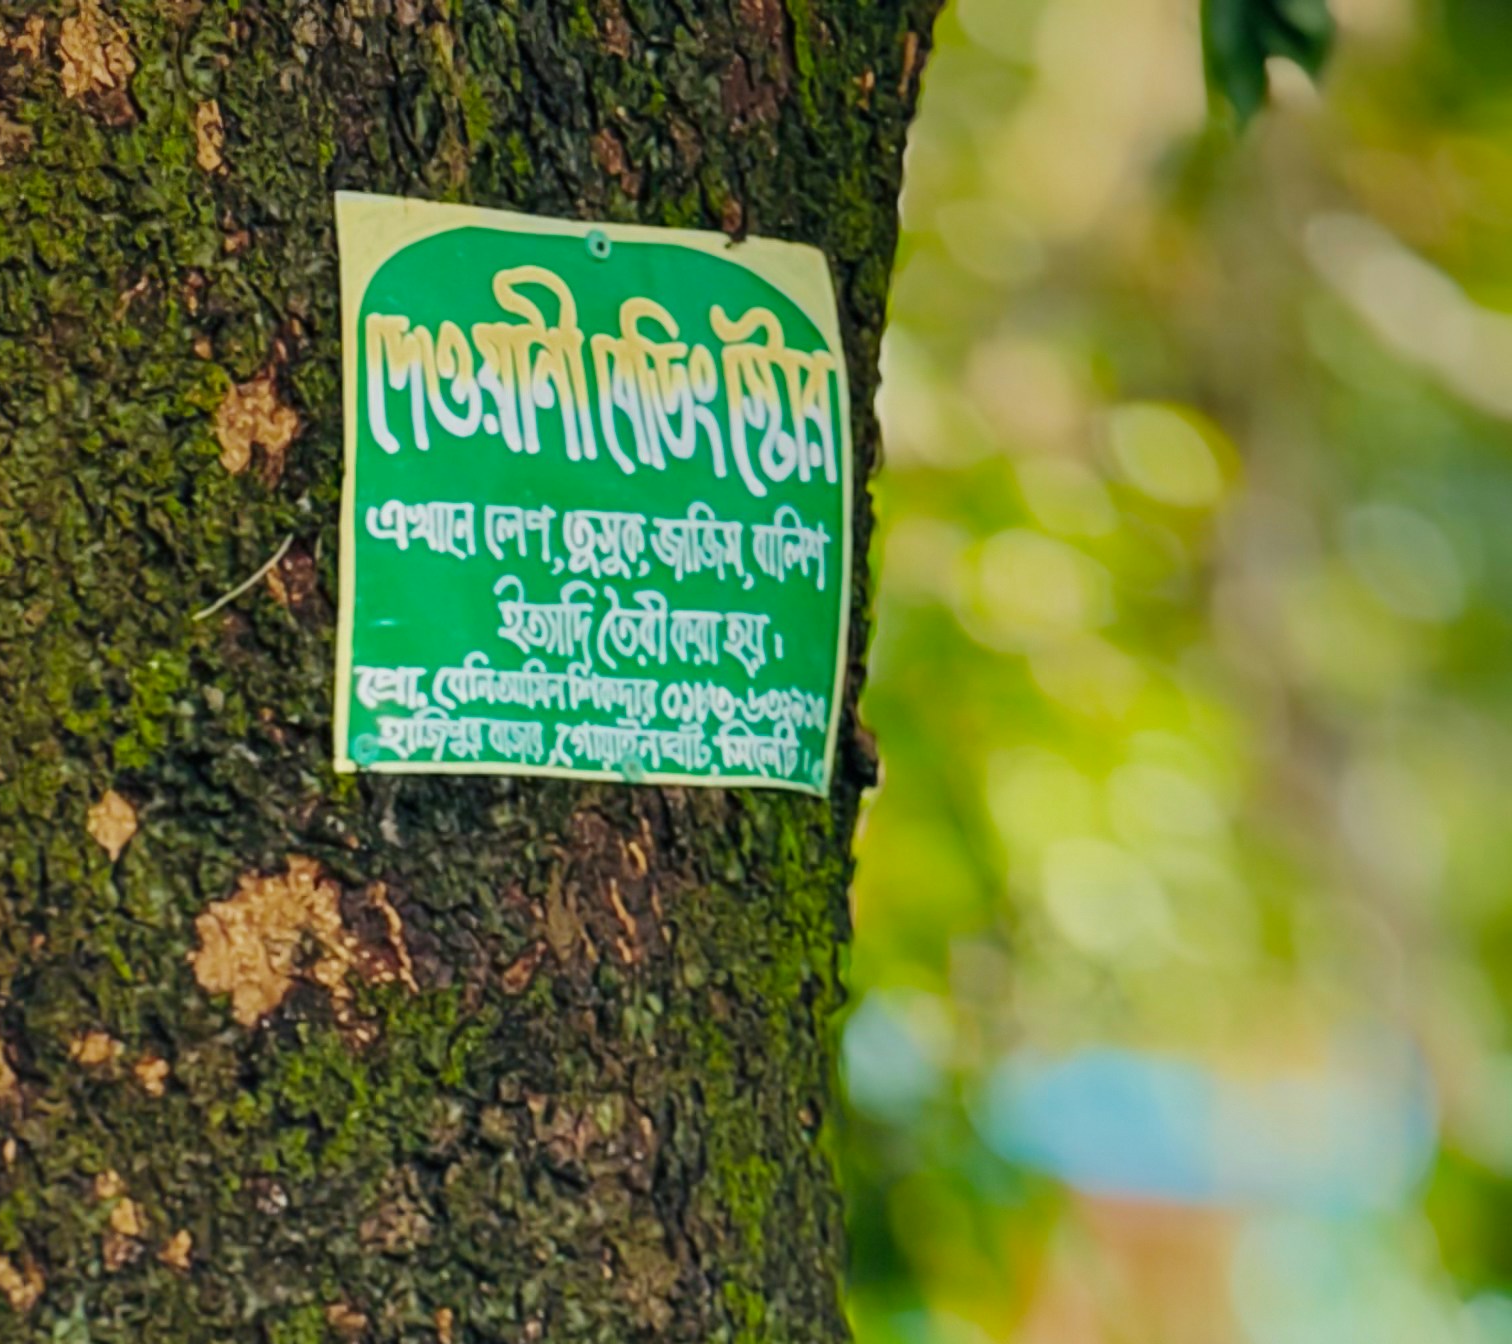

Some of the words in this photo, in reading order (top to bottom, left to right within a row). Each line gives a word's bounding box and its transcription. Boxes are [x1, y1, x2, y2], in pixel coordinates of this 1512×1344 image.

[365, 499, 476, 560] এখানে
[752, 506, 832, 591] বালিশ
[670, 610, 725, 666] করা
